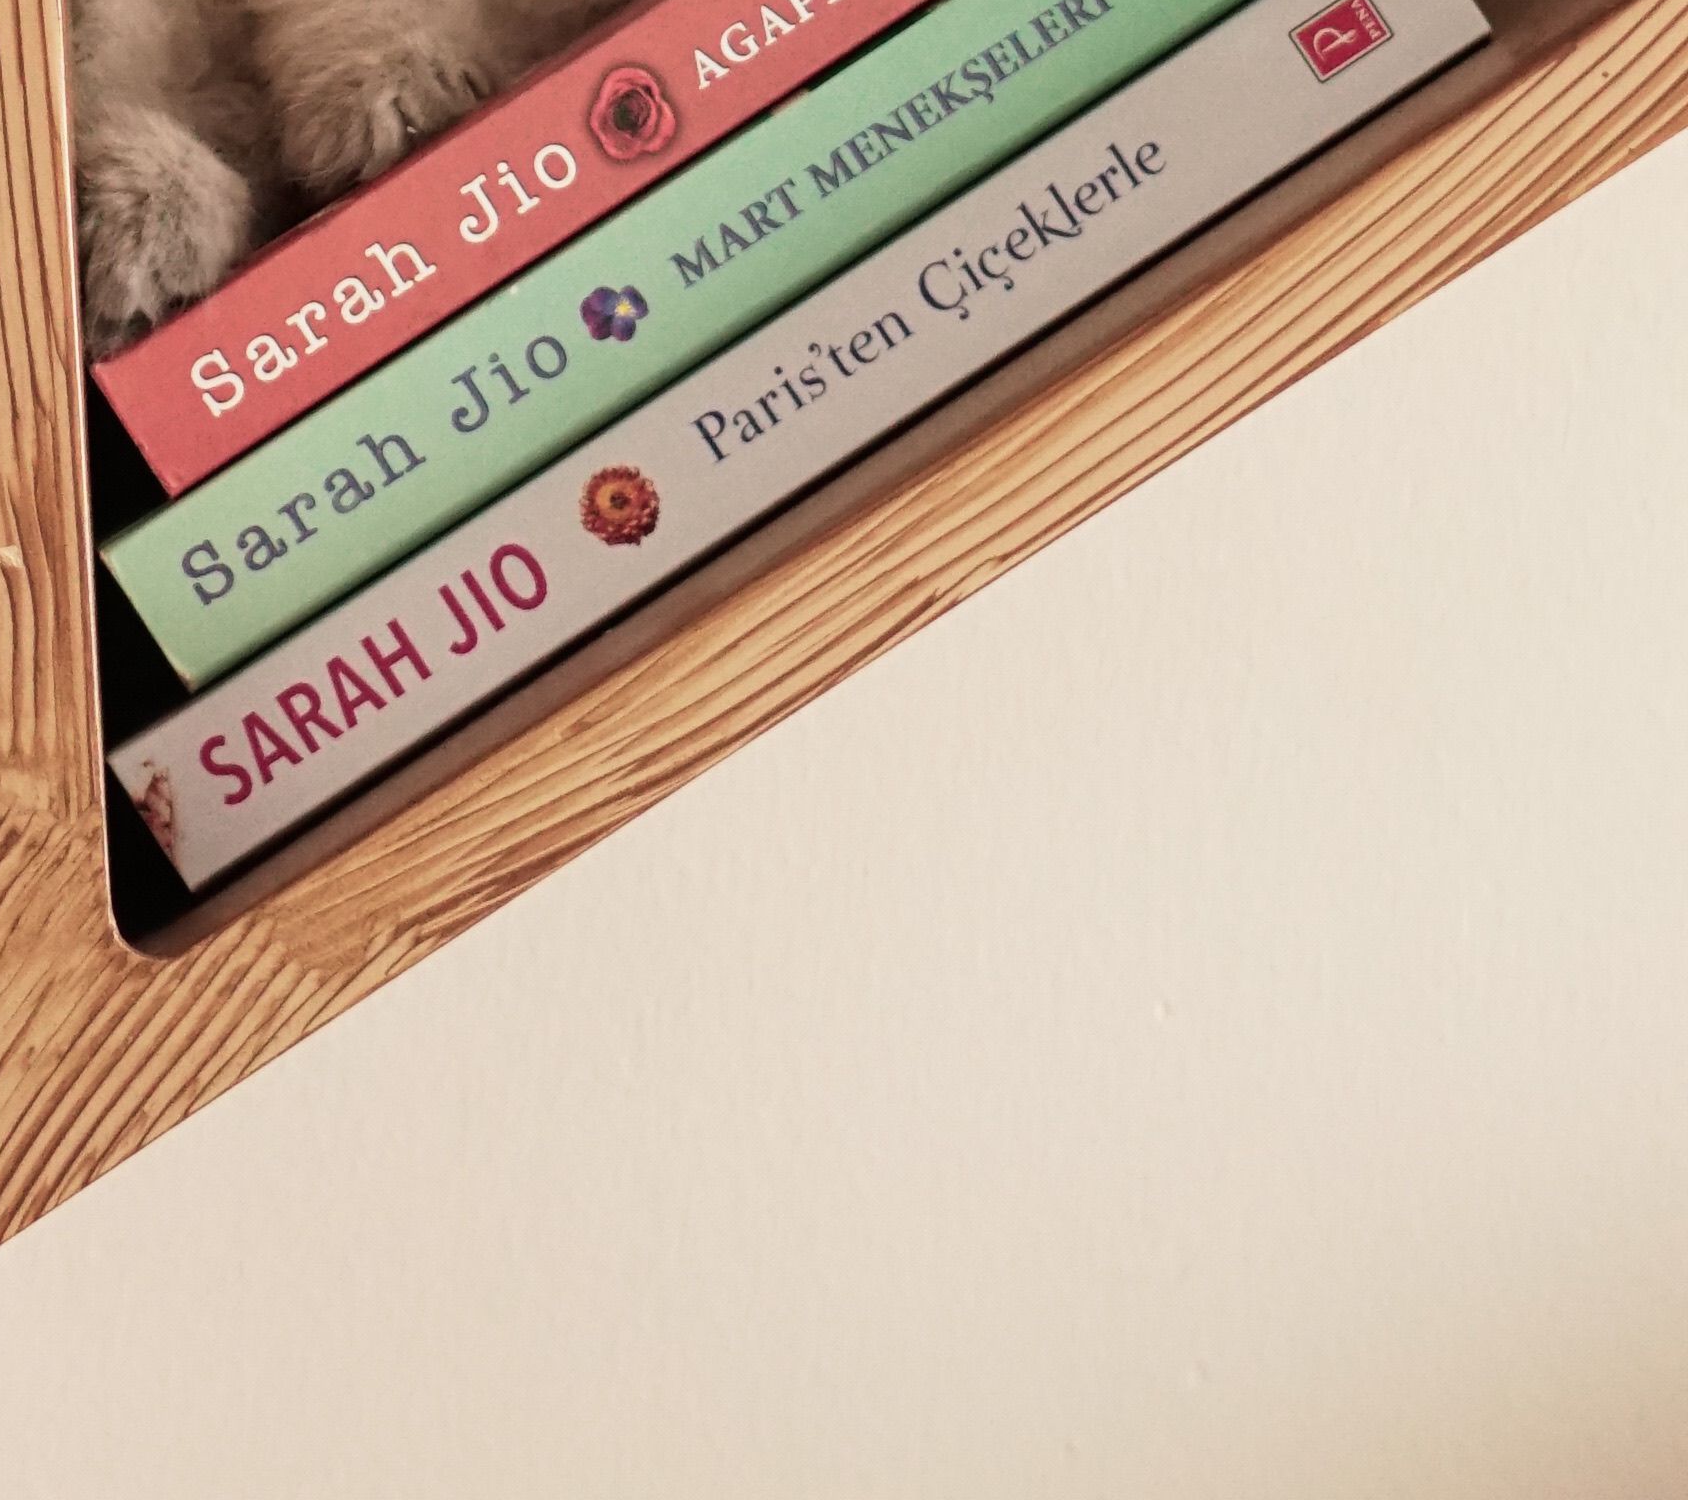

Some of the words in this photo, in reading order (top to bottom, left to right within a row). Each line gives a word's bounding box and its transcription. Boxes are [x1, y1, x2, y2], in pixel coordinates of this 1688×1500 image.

[180, 432, 428, 607] Sarah
[452, 334, 568, 436] Jio
[668, 180, 805, 290] MART
[190, 240, 437, 417] Sarah
[458, 143, 579, 246] Jio
[199, 619, 431, 805] SARAH
[438, 541, 549, 655] JIO
[690, 309, 914, 466] Paris'ten
[918, 136, 1169, 322] Çiçeklerle
